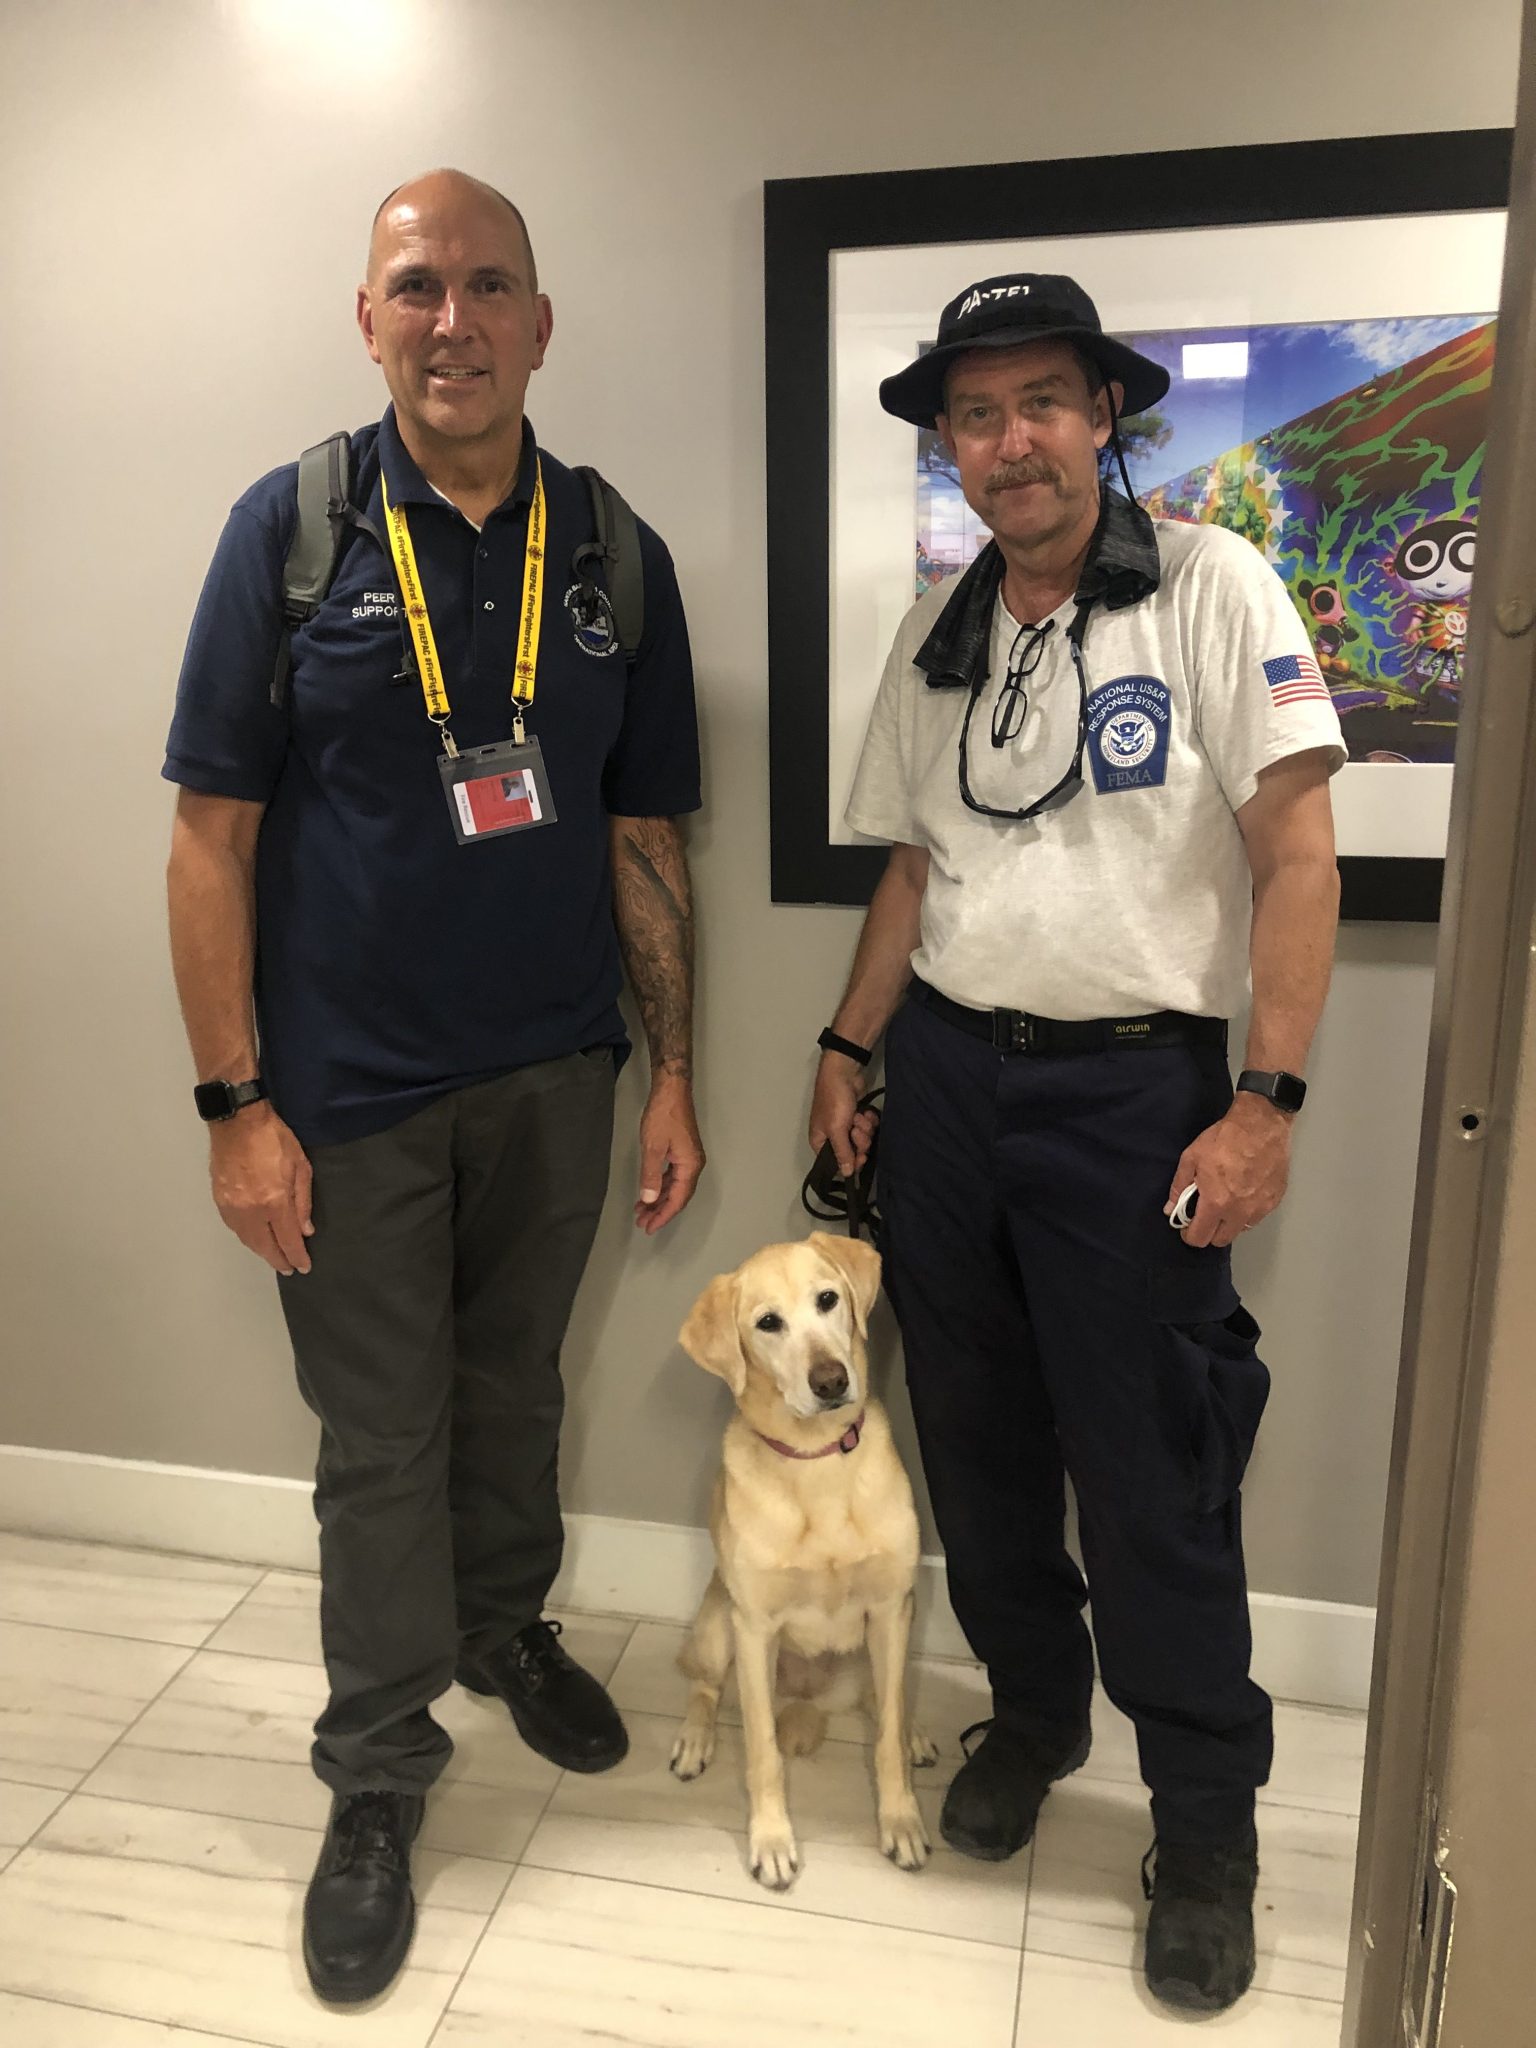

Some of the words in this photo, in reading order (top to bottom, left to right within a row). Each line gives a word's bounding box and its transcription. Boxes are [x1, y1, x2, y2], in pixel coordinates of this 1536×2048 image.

[957, 285, 1030, 320] PA-TF1
[528, 563, 538, 592] FIREPAC
[363, 592, 396, 603] PEER
[417, 623, 431, 655] FIREPAC
[522, 593, 537, 658] #FireFightersFirst
[1087, 682, 1137, 714] NATIONAL
[1139, 682, 1167, 702] US&R
[1088, 694, 1134, 732] RESPONSE
[1134, 695, 1168, 723] SYSTEM
[1106, 769, 1153, 788] FEMA
